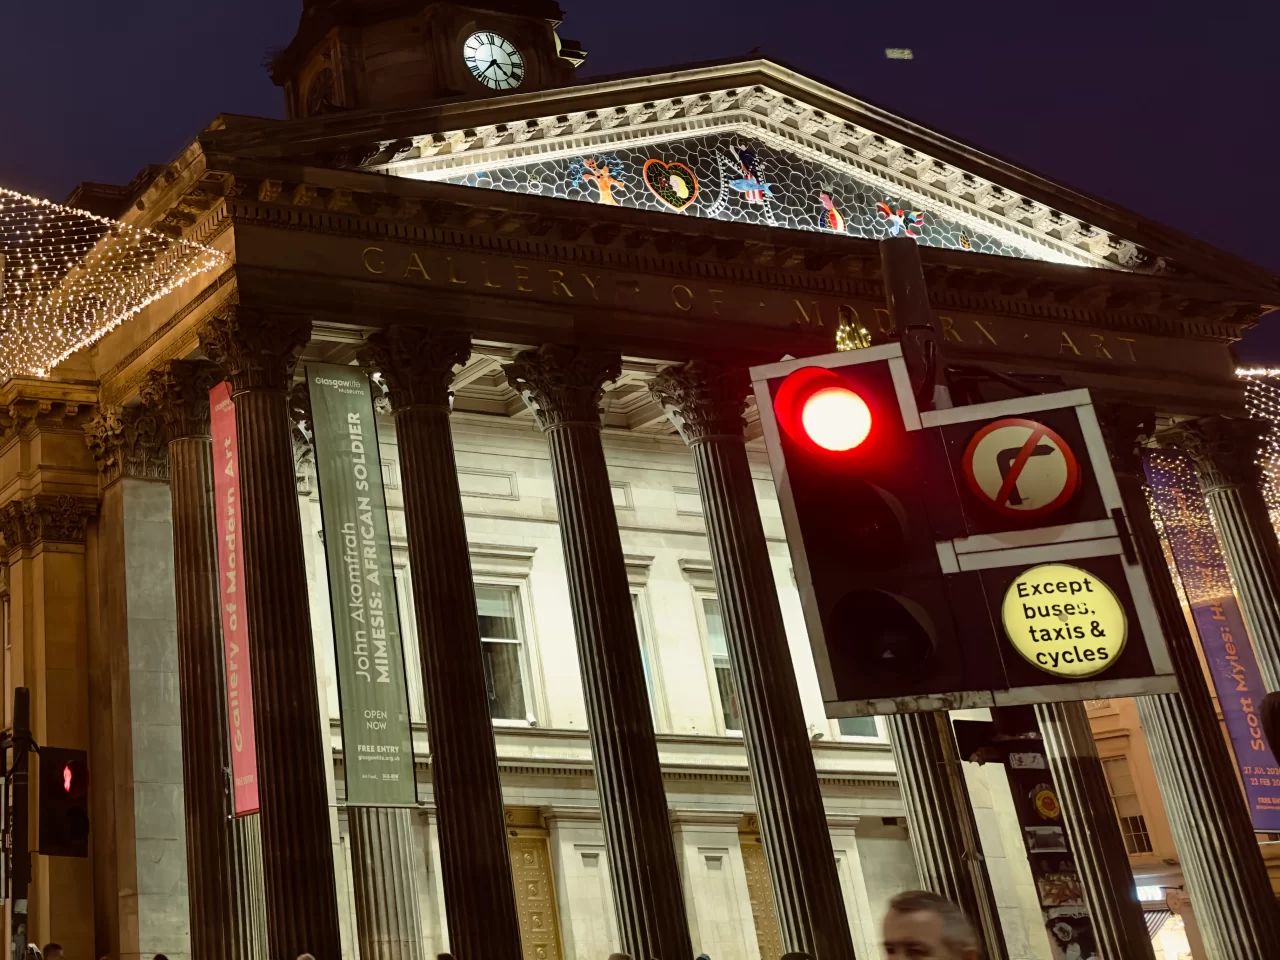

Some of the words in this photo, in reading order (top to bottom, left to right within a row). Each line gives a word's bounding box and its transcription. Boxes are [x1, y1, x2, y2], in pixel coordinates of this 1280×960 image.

[360, 246, 602, 301] GALLERY
[670, 284, 725, 316] OF
[793, 298, 999, 346] MODRN
[1058, 330, 1138, 362] ART
[223, 435, 235, 477] Art
[347, 411, 370, 492] SOLDIER
[225, 487, 237, 594] Modern
[357, 496, 381, 587] AFRICAN
[341, 521, 366, 624] Akomfrah
[1016, 577, 1094, 598] Except
[225, 603, 238, 632] of
[370, 590, 391, 684] MIMESIS:
[1028, 623, 1086, 643] taxis
[1090, 620, 1107, 638] &
[353, 628, 371, 683] John
[1036, 645, 1109, 668] cycles
[229, 641, 243, 753] Gallery
[364, 710, 388, 719] OPEN
[1242, 696, 1265, 752] Scott
[357, 744, 375, 753] FREE
[376, 745, 400, 754] ENTRY
[366, 721, 387, 730] NOW
